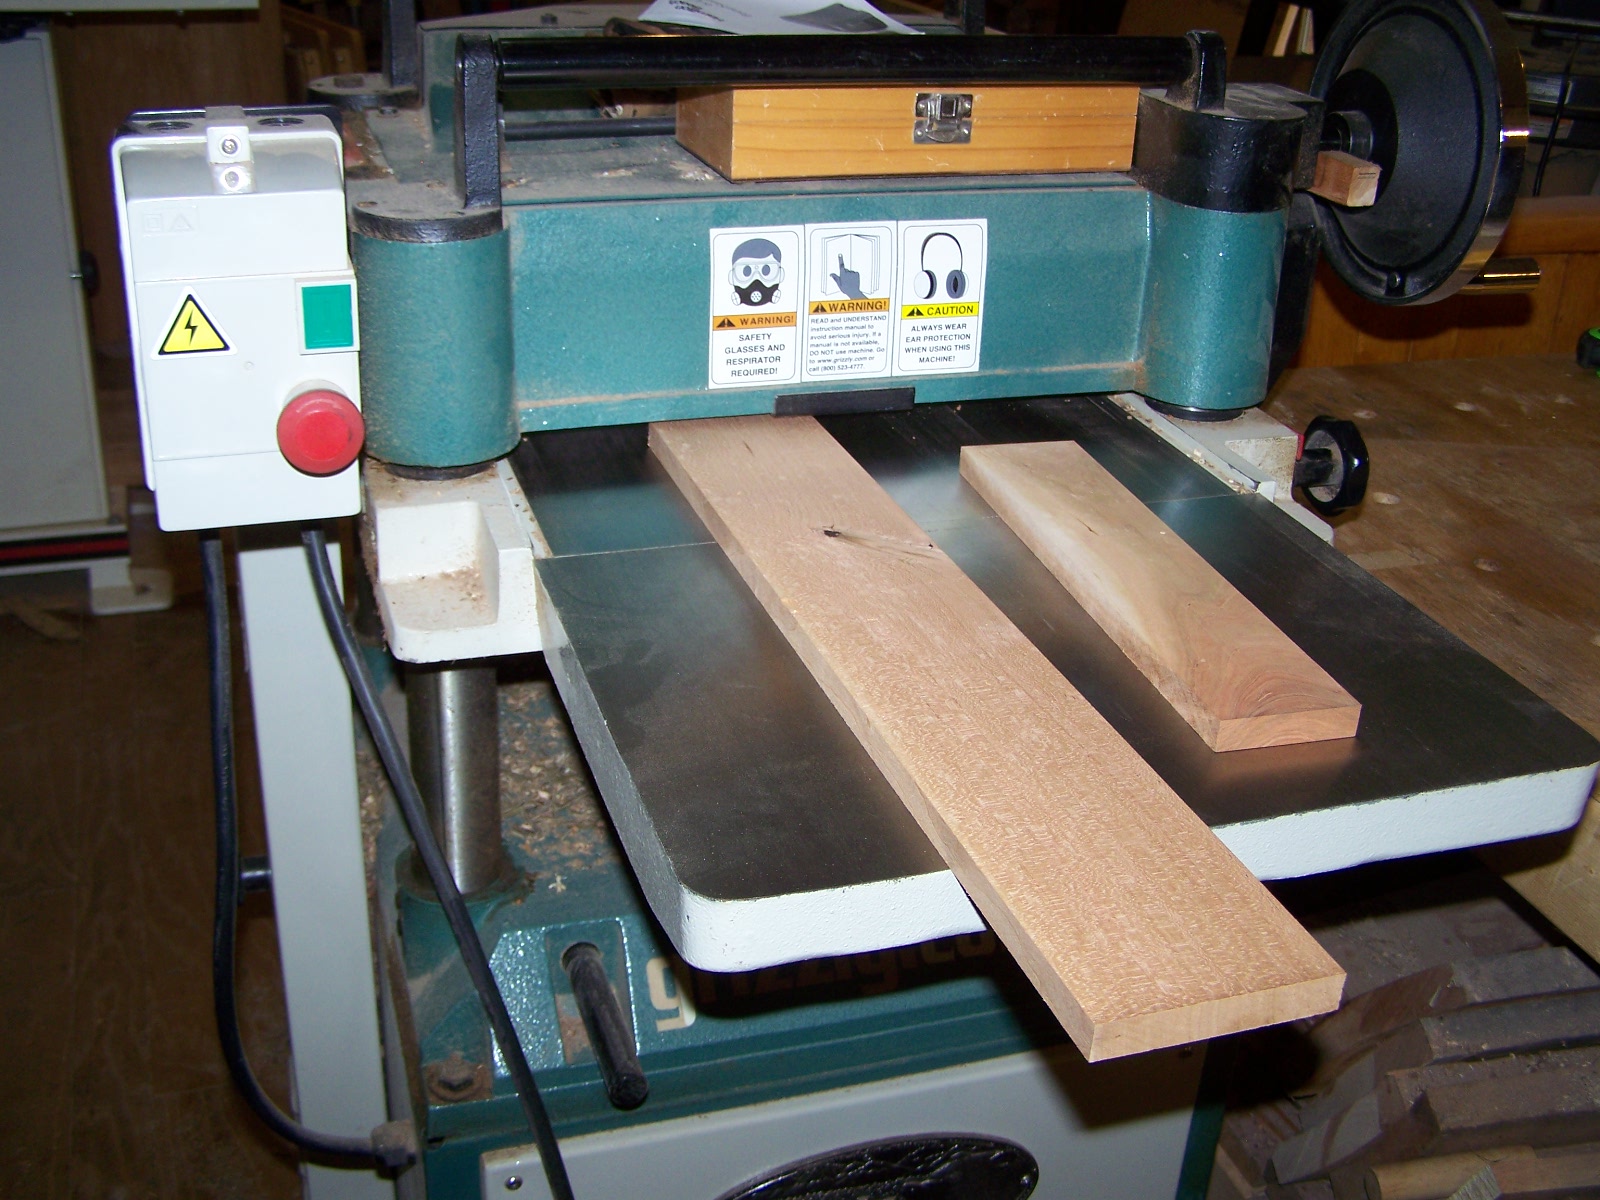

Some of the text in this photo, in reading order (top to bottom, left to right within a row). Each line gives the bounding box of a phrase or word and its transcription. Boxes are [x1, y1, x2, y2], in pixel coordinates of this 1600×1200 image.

[829, 301, 886, 312] WARNING!
[927, 305, 973, 315] CAUTION
[740, 316, 793, 326] WARNING!
[739, 333, 772, 341] SAFETY
[924, 334, 971, 342] PROTECTION
[725, 345, 764, 354] GLASSES
[726, 356, 781, 366] RESPIRATOR
[731, 368, 778, 377] REQUIRED!
